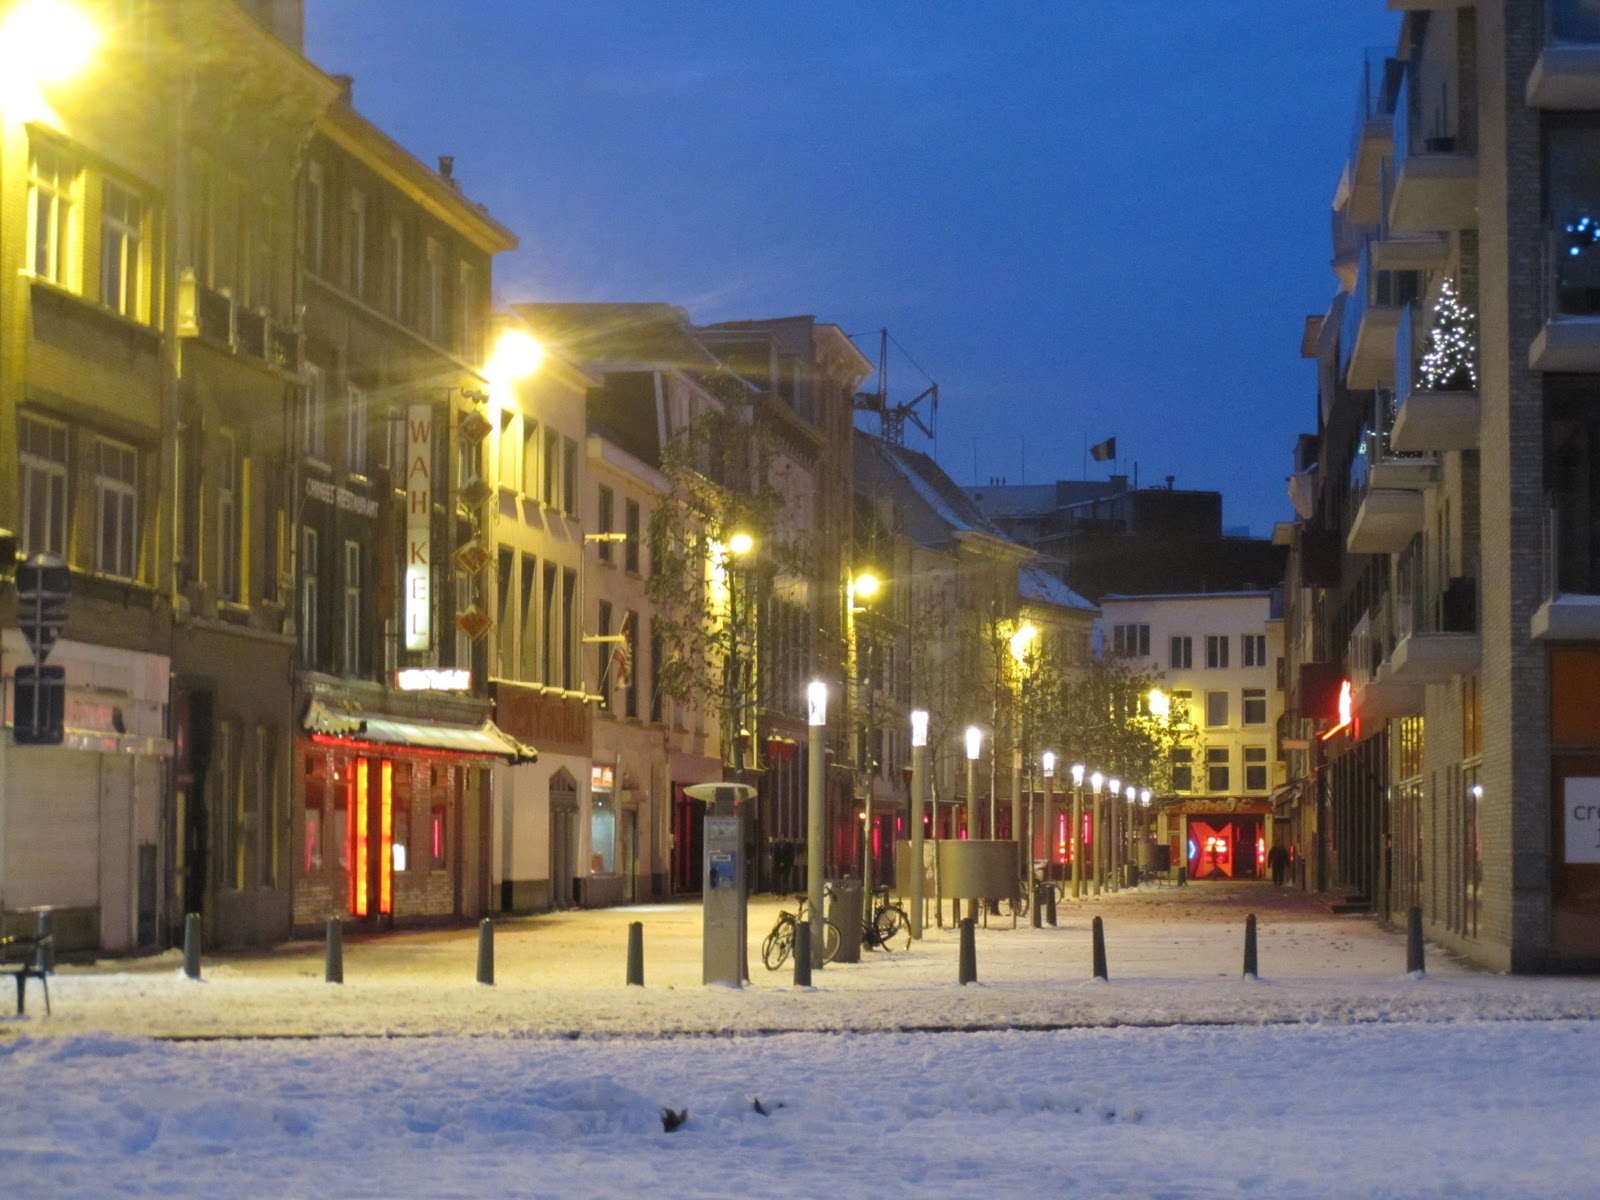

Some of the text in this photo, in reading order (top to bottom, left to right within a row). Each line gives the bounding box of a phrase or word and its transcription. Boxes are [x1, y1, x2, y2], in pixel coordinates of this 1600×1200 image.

[410, 419, 431, 636] WAH KEL
[1573, 804, 1600, 821] cr
